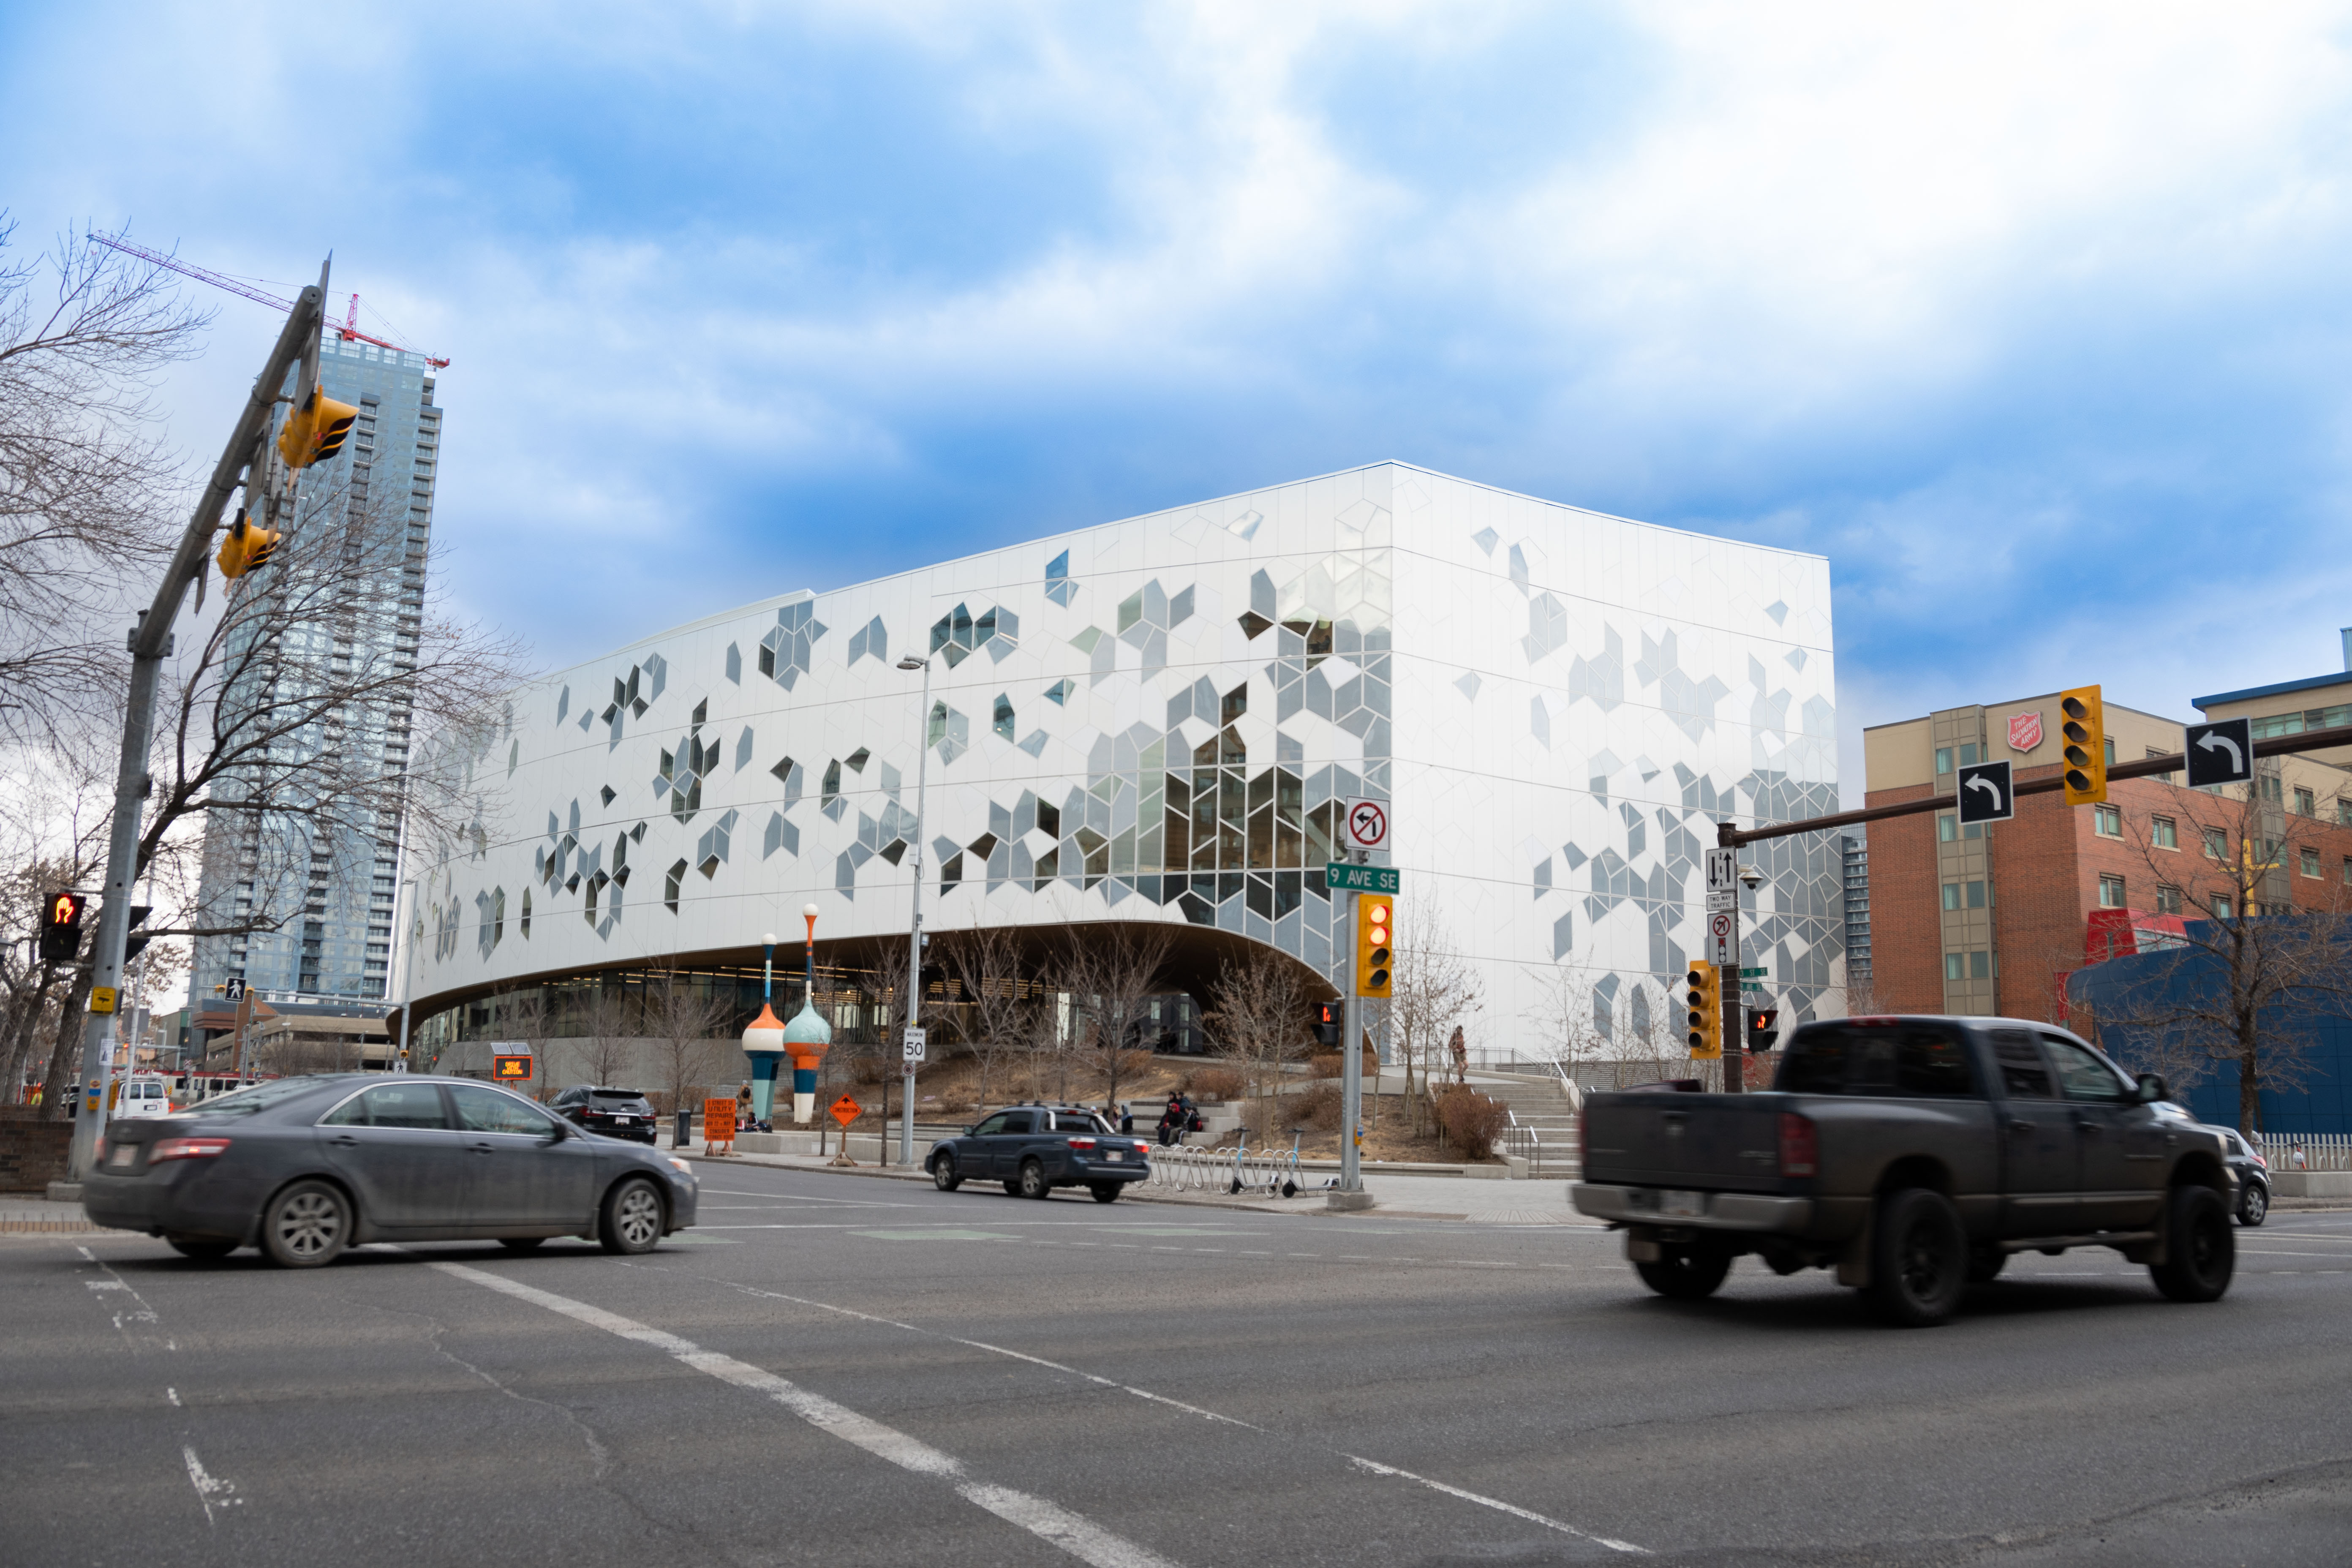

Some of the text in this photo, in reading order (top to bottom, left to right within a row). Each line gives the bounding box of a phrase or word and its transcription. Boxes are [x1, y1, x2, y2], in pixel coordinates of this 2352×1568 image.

[2011, 716, 2037, 743] SALVATION
[2014, 717, 2026, 730] THE
[2021, 727, 2036, 746] ARMY
[1330, 868, 1396, 889] 9 AVE SE
[906, 1042, 923, 1056] 50
